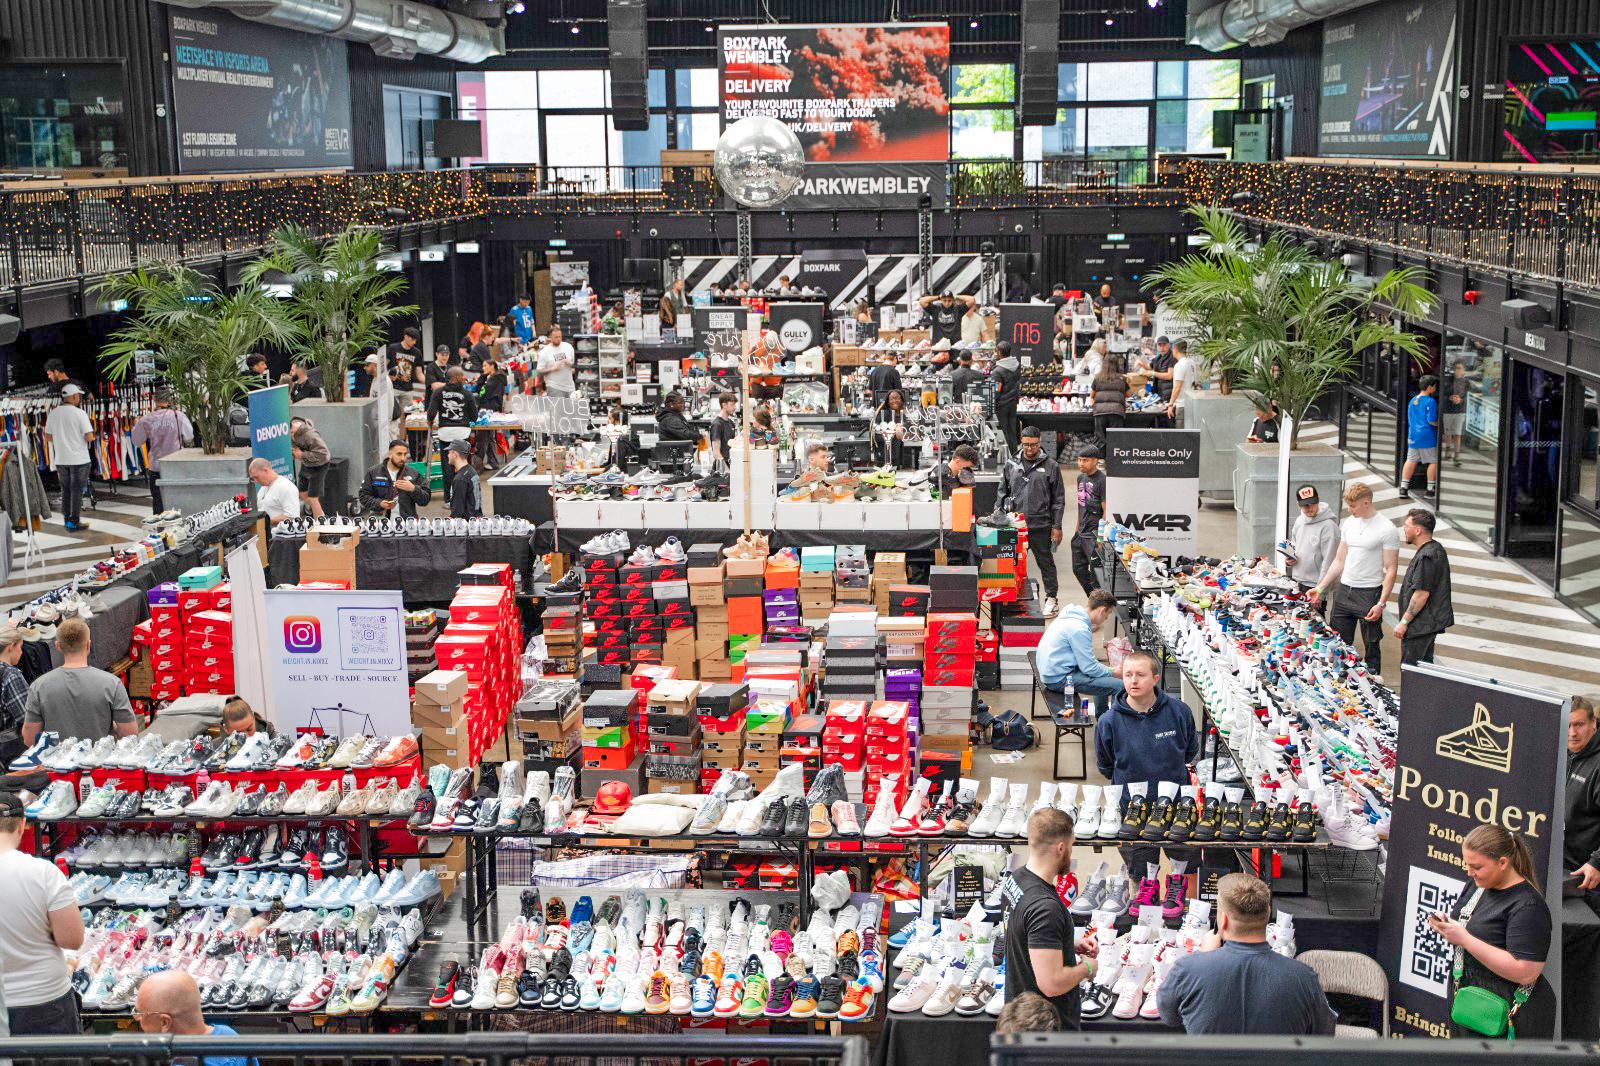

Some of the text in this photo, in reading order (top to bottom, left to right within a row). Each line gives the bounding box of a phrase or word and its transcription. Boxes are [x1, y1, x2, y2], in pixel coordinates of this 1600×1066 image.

[724, 37, 786, 50] BOXPARK
[724, 50, 791, 63] WEMBLEY
[725, 80, 791, 93] DELIVERY
[725, 98, 896, 110] YOUR FAVOURITE BOXPARK TRADERS
[780, 109, 802, 119] FAST
[804, 109, 816, 118] TO
[817, 109, 844, 118] YOUR
[846, 108, 876, 118] DOOR.
[789, 177, 931, 195] PARKWEMBLEY
[804, 264, 840, 272] BOXPARK
[256, 423, 289, 442] DENOVO
[1113, 448, 1192, 459] For Resale Only
[1397, 766, 1546, 838] Ponder
[1429, 823, 1464, 844] Follo
